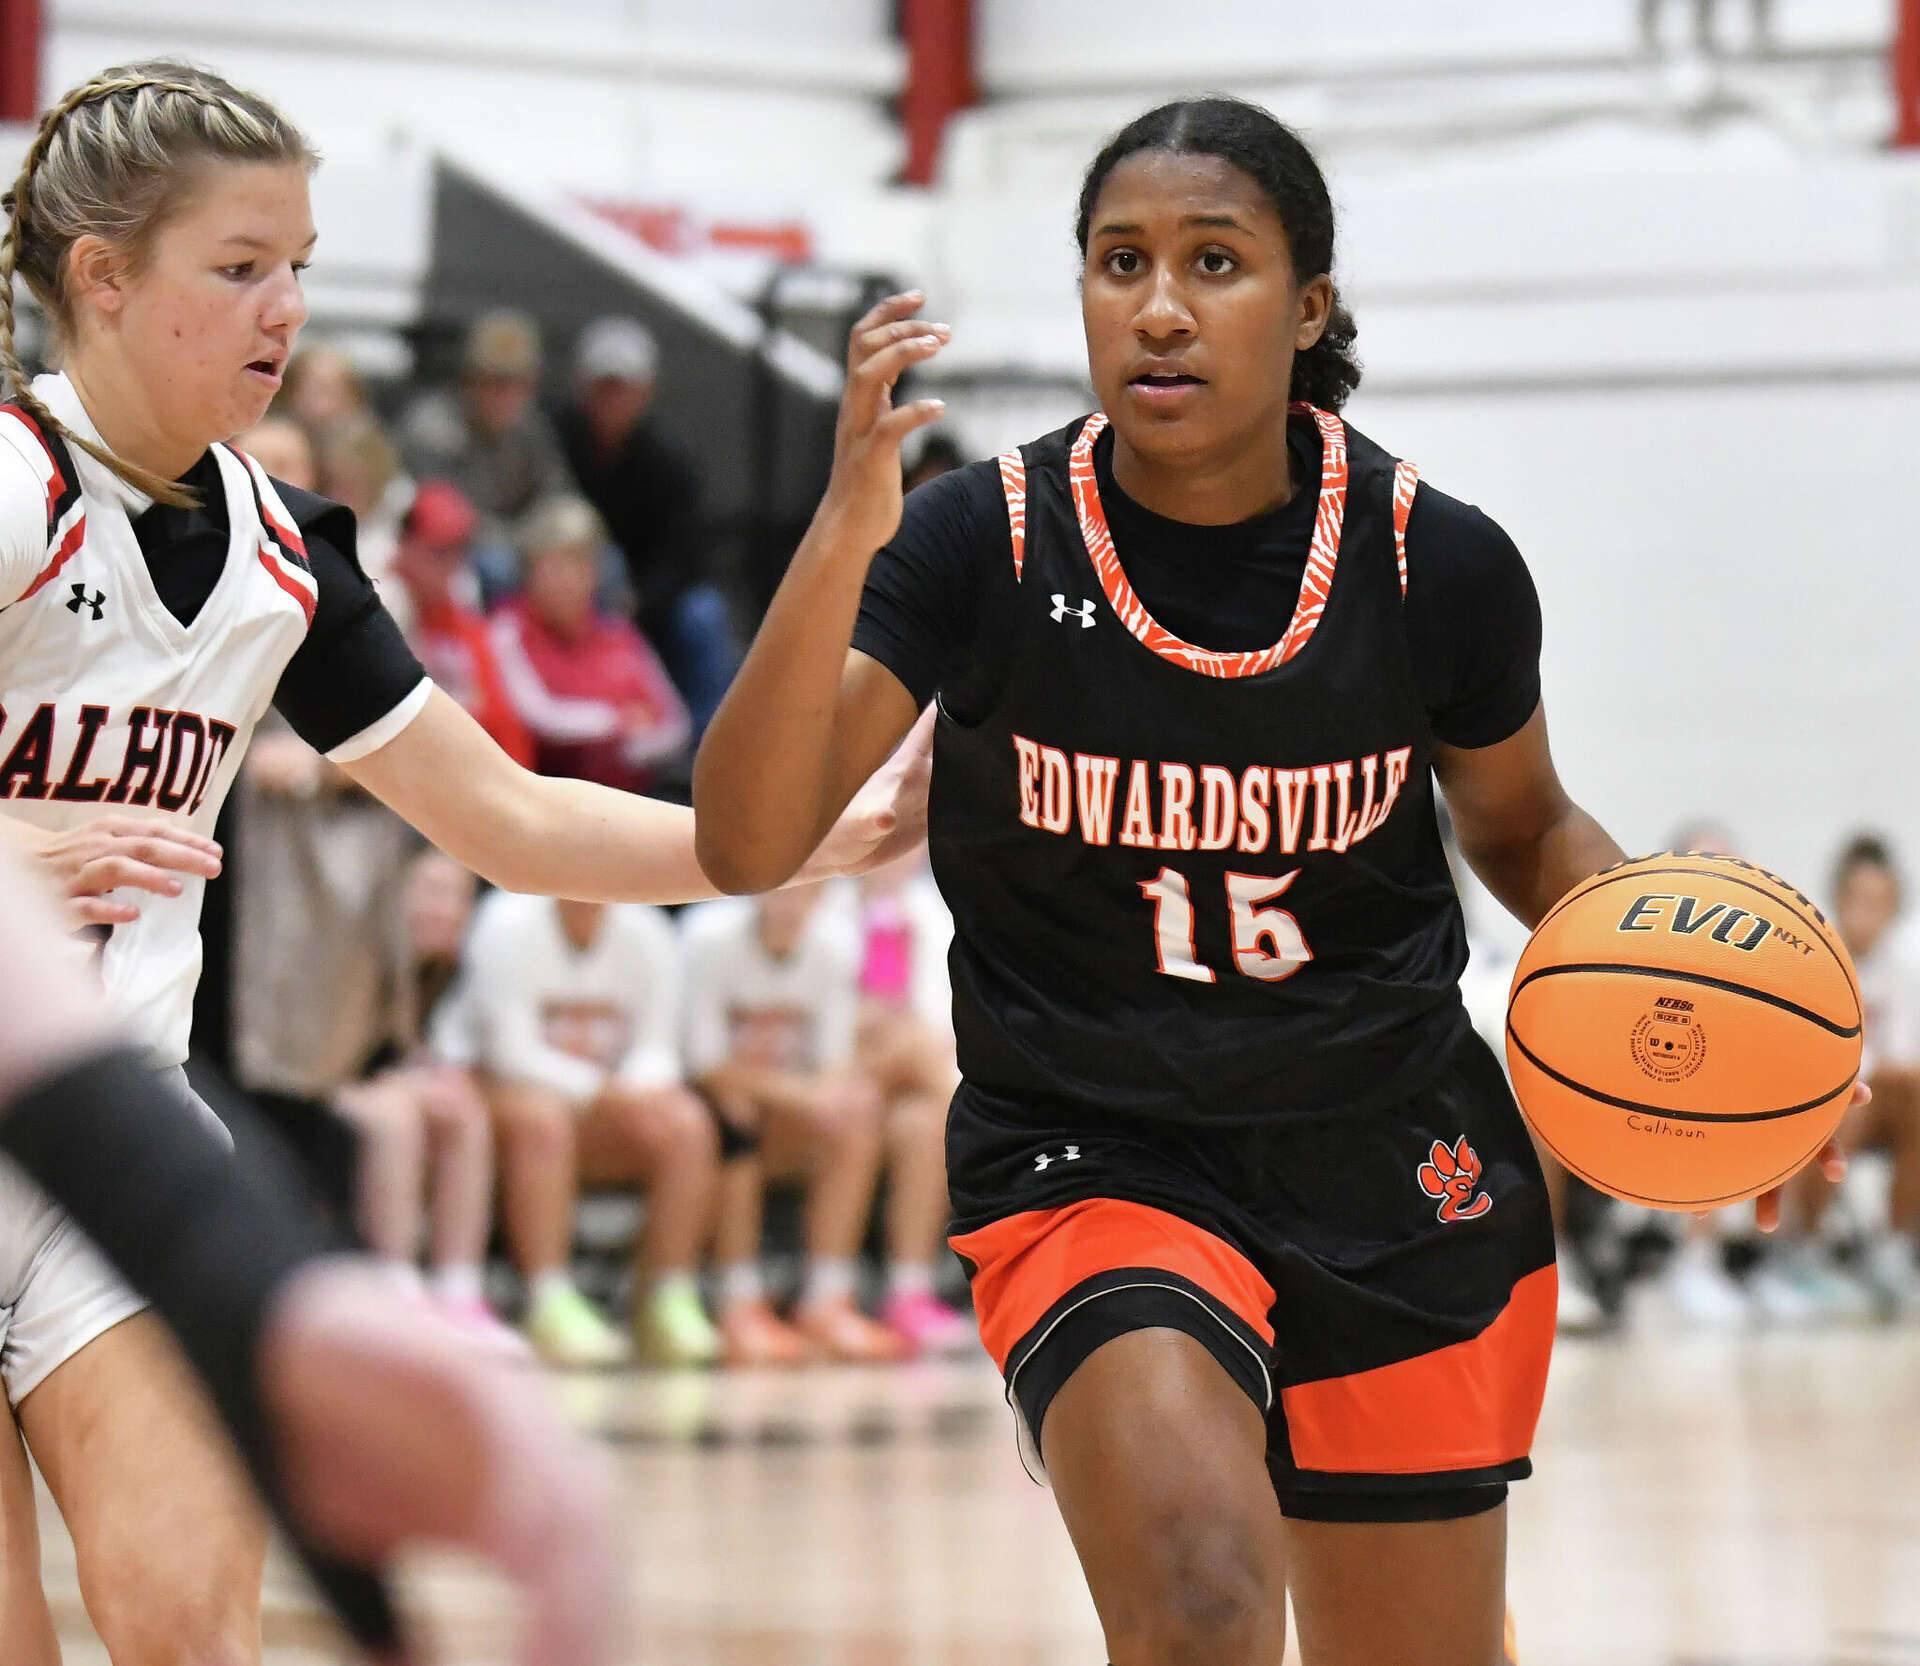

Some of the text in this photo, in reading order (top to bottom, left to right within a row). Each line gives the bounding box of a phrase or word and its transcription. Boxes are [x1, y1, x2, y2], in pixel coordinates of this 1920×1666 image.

[1012, 734, 1412, 854] EDWARDSVILLE
[1136, 866, 1314, 983] 15
[1616, 893, 1774, 952] EVO
[1773, 927, 1815, 955] NXT
[1656, 1013, 1678, 1023] SIZE
[1627, 1115, 1705, 1139] Calhoun
